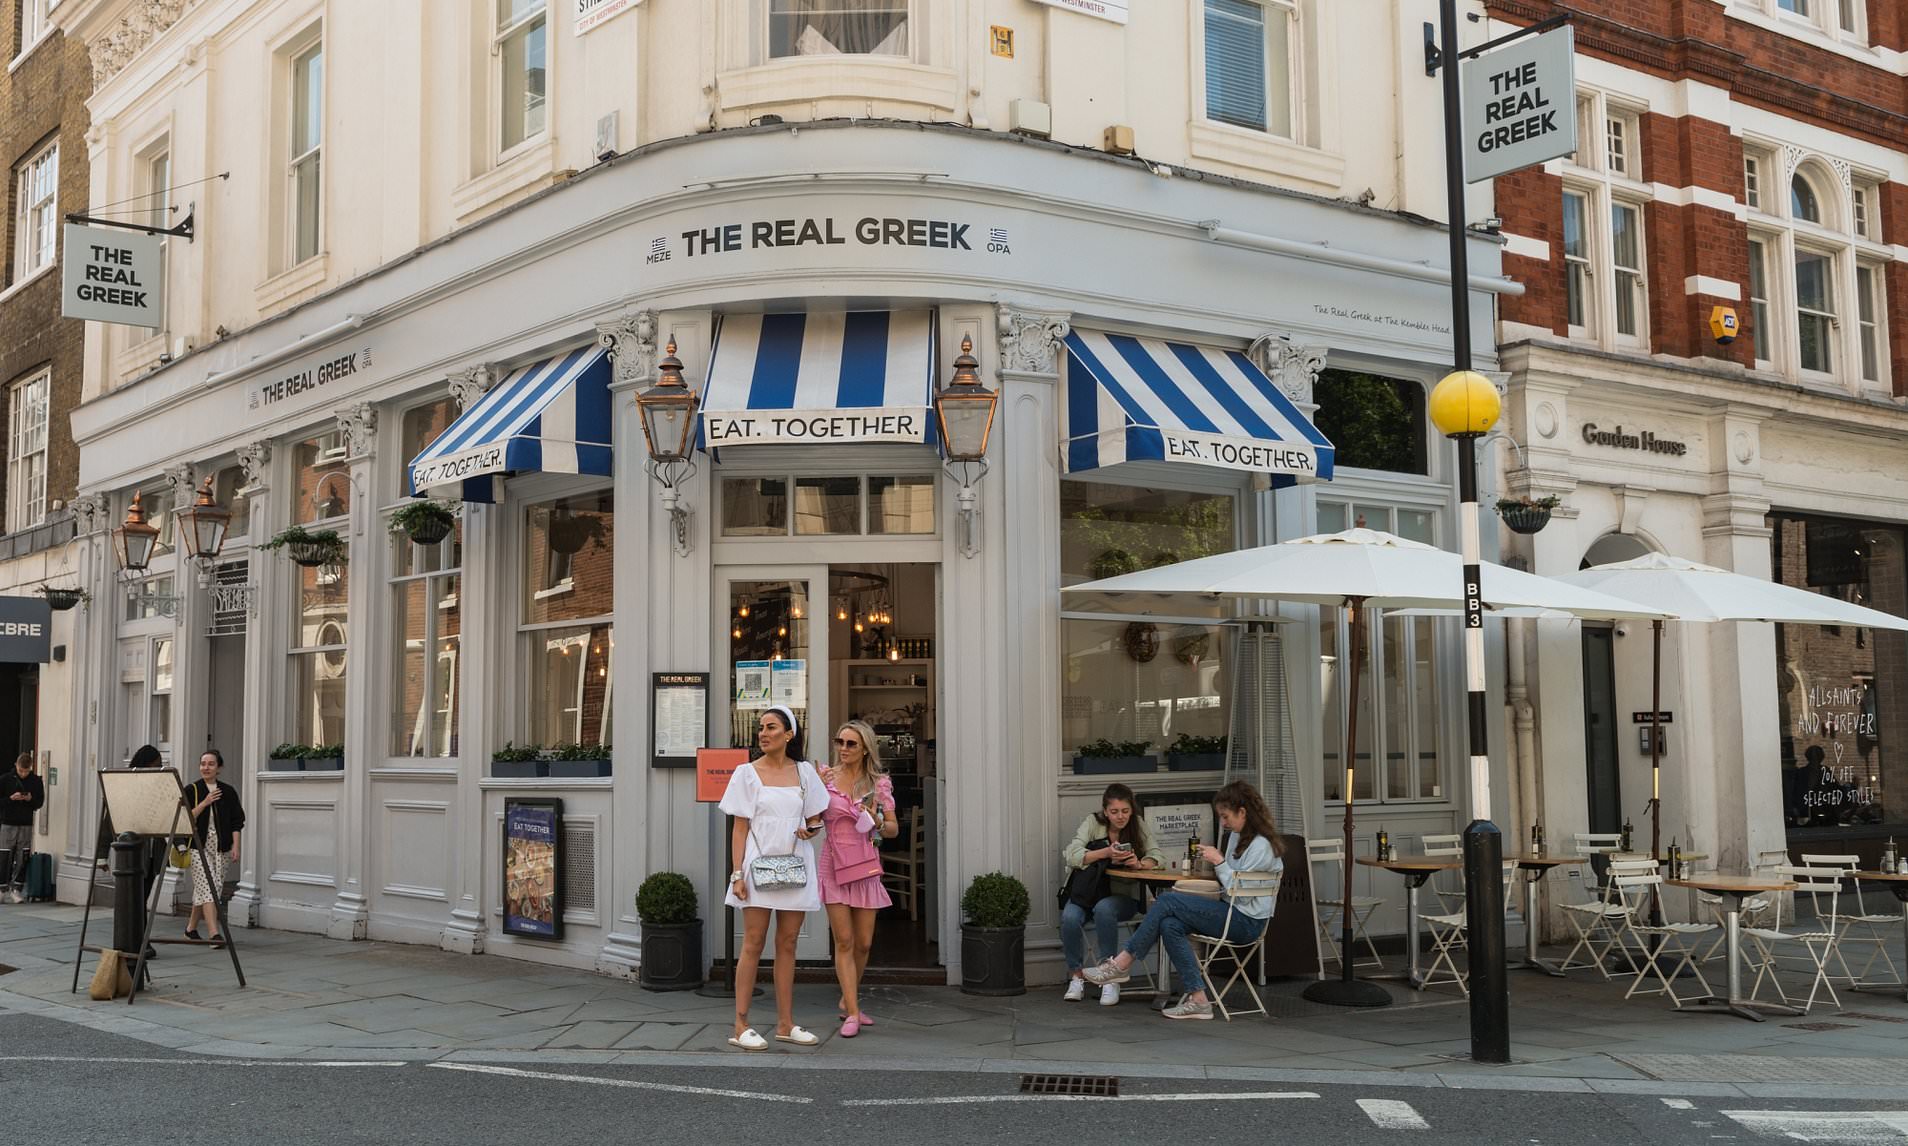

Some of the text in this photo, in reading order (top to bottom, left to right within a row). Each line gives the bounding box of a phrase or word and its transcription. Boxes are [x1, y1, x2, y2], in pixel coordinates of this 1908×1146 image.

[1489, 61, 1537, 96] THE
[1485, 87, 1550, 125] REAL
[1478, 110, 1558, 153] GREEK
[682, 217, 972, 257] THE REAL GREEK
[986, 242, 1011, 255] OPA
[90, 244, 133, 266] THE
[646, 250, 672, 265] MEZE
[85, 264, 142, 288] REAL
[76, 285, 147, 309] GREEK
[1313, 304, 1329, 315] The
[1331, 307, 1349, 318] Real
[1350, 311, 1372, 322] Greek
[1384, 316, 1400, 326] The
[262, 353, 357, 405] THE REAL GREEK
[709, 415, 919, 440] EAT. TOGETHER.
[1167, 437, 1314, 471] EAT. TOGETHER.
[1641, 430, 1687, 456] House
[414, 448, 502, 487] EAT. TOGETHER.
[1798, 711, 1875, 735] AND FOREVER
[1840, 765, 1855, 783] OFF
[1803, 786, 1875, 807] SELECTED STYLES
[513, 822, 550, 834] EAT TOGETHER
